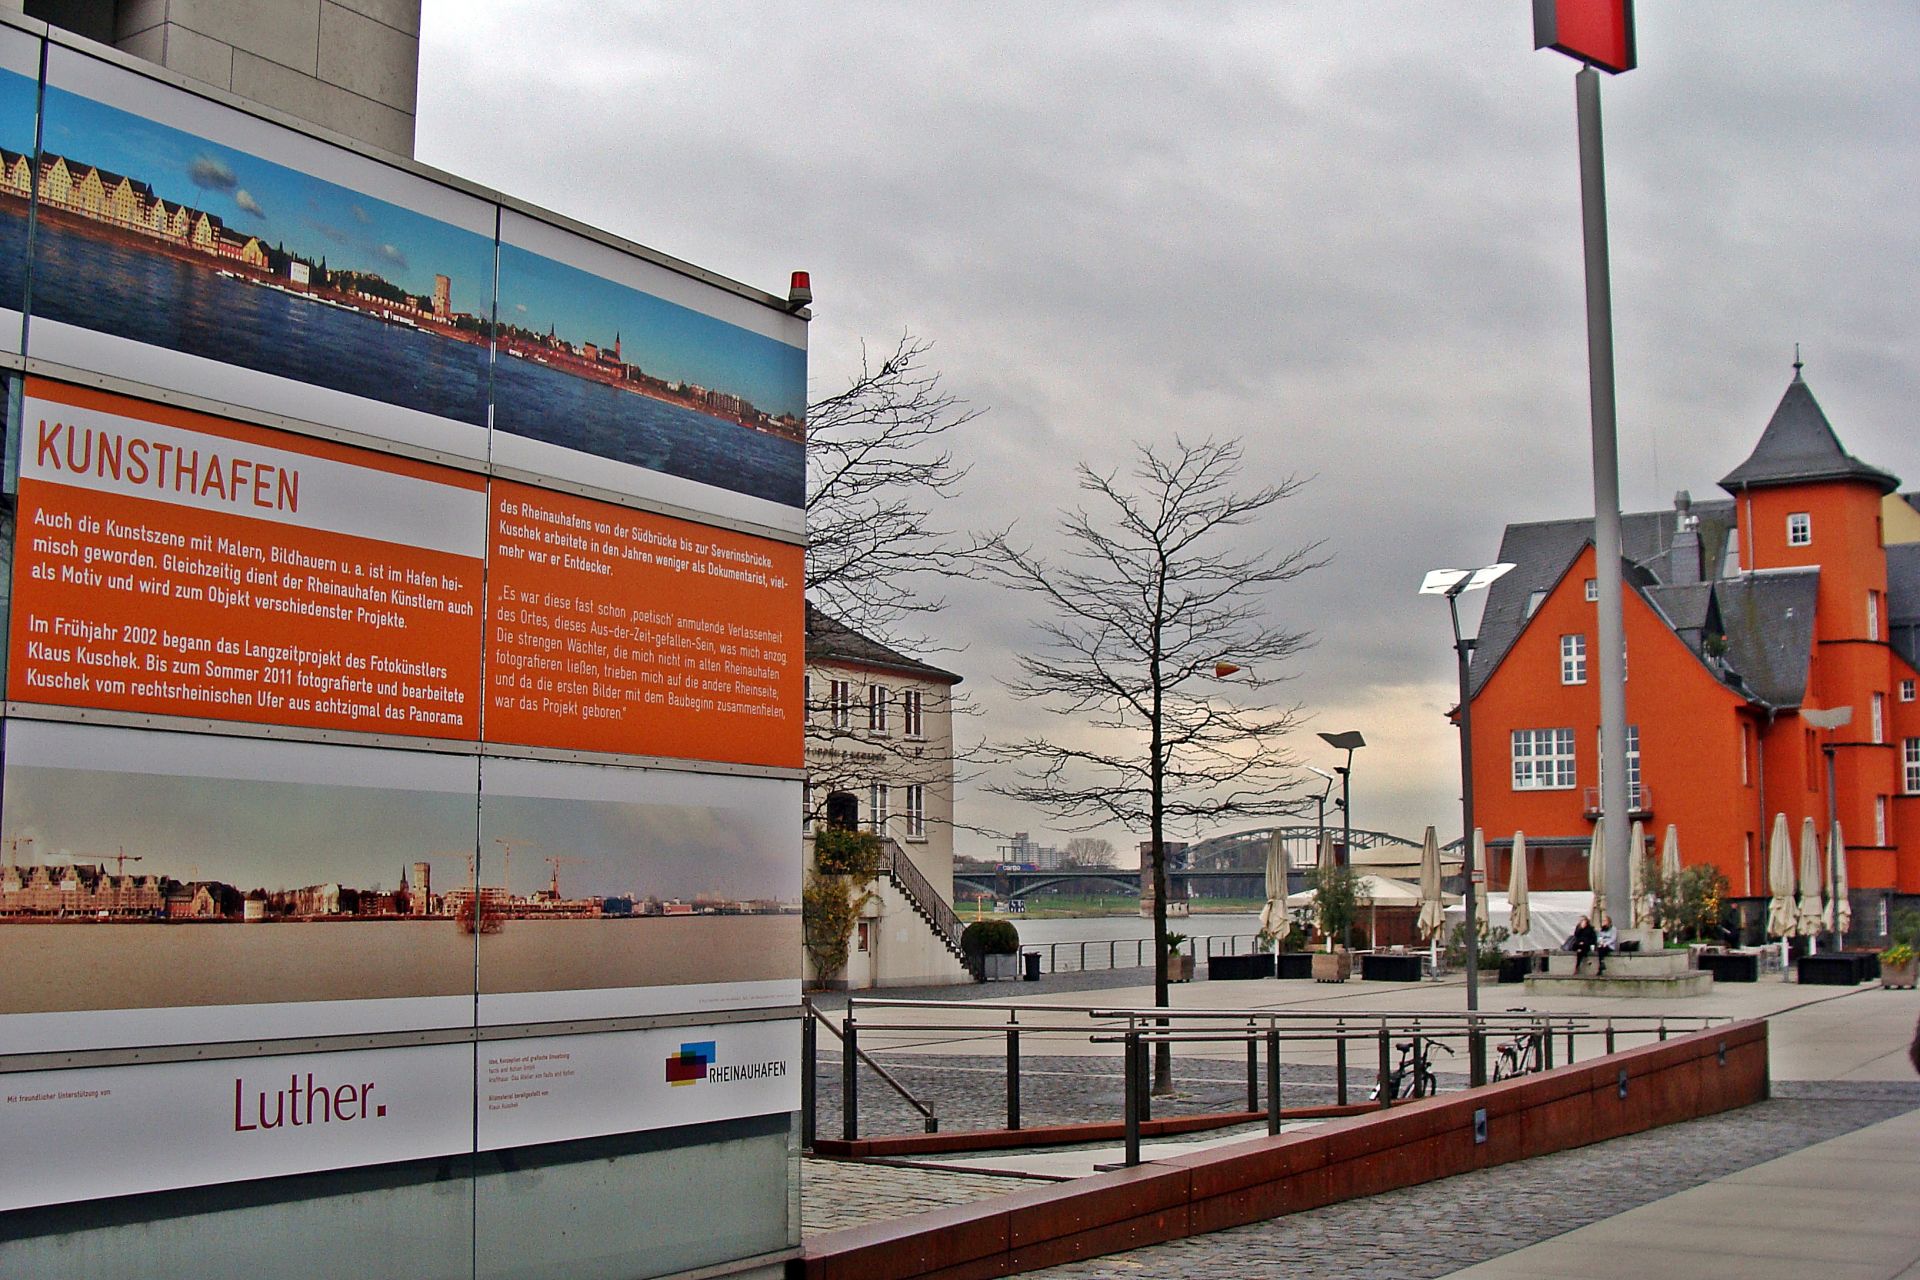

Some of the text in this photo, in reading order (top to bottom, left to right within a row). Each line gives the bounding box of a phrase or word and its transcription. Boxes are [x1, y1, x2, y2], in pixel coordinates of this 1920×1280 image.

[37, 420, 299, 513] KUNSTHAFEN
[34, 507, 463, 591] Auch die Kunstszene mit Malern, Bildhauern u. a. ist im Hafen hei-
[499, 519, 788, 589] Kuschek arbeitete in den Jahren weniger als Dokumentarist, viel-
[499, 544, 613, 576] mehr war er Entdecker.
[500, 498, 773, 568] des Rheinauhafens von der Südbrücke bis zur Severinsbrücke.
[31, 561, 407, 629] als Motiv und wird zum Objekt verschiedenster Projekte.
[33, 536, 473, 616] misch geworden. Gleichzeitig dient der Rheinauhafen Künstlern auch
[497, 606, 515, 622] des
[520, 609, 550, 630] Ortes,
[554, 615, 586, 633] dieses
[719, 644, 736, 655] was
[739, 645, 760, 659] mich
[520, 591, 540, 604] war
[544, 592, 571, 609] diese
[575, 596, 593, 613] fast
[597, 602, 626, 618] schon
[676, 617, 725, 634] anmutende
[727, 622, 783, 643] Verlassenheit
[28, 640, 464, 703] Klaus Kuschek. Bis zum Sommer 2011 fotografierte und bearbeitete
[29, 614, 447, 679] Im Frühjahr 2002 begann das Langzeitprojekt des Fotokünstlers
[495, 648, 779, 701] fotografieren ließen, trieben mich auf die andere Rheinseite,
[496, 626, 780, 680] Die strengen Wächter, die mich nicht im alten Rheinauhafen
[27, 667, 463, 725] Kuschek vom rechtsrheinischen Ufer aus achtzigmal das Panorama
[494, 696, 515, 708] war
[519, 695, 538, 711] das
[543, 697, 578, 717] Projekt
[495, 672, 785, 720] und da die ersten Bilder mit dem Baubeginn zusammenfielen,
[709, 1060, 786, 1083] RHEINAUHAFEN
[235, 1073, 387, 1131] Luther.
